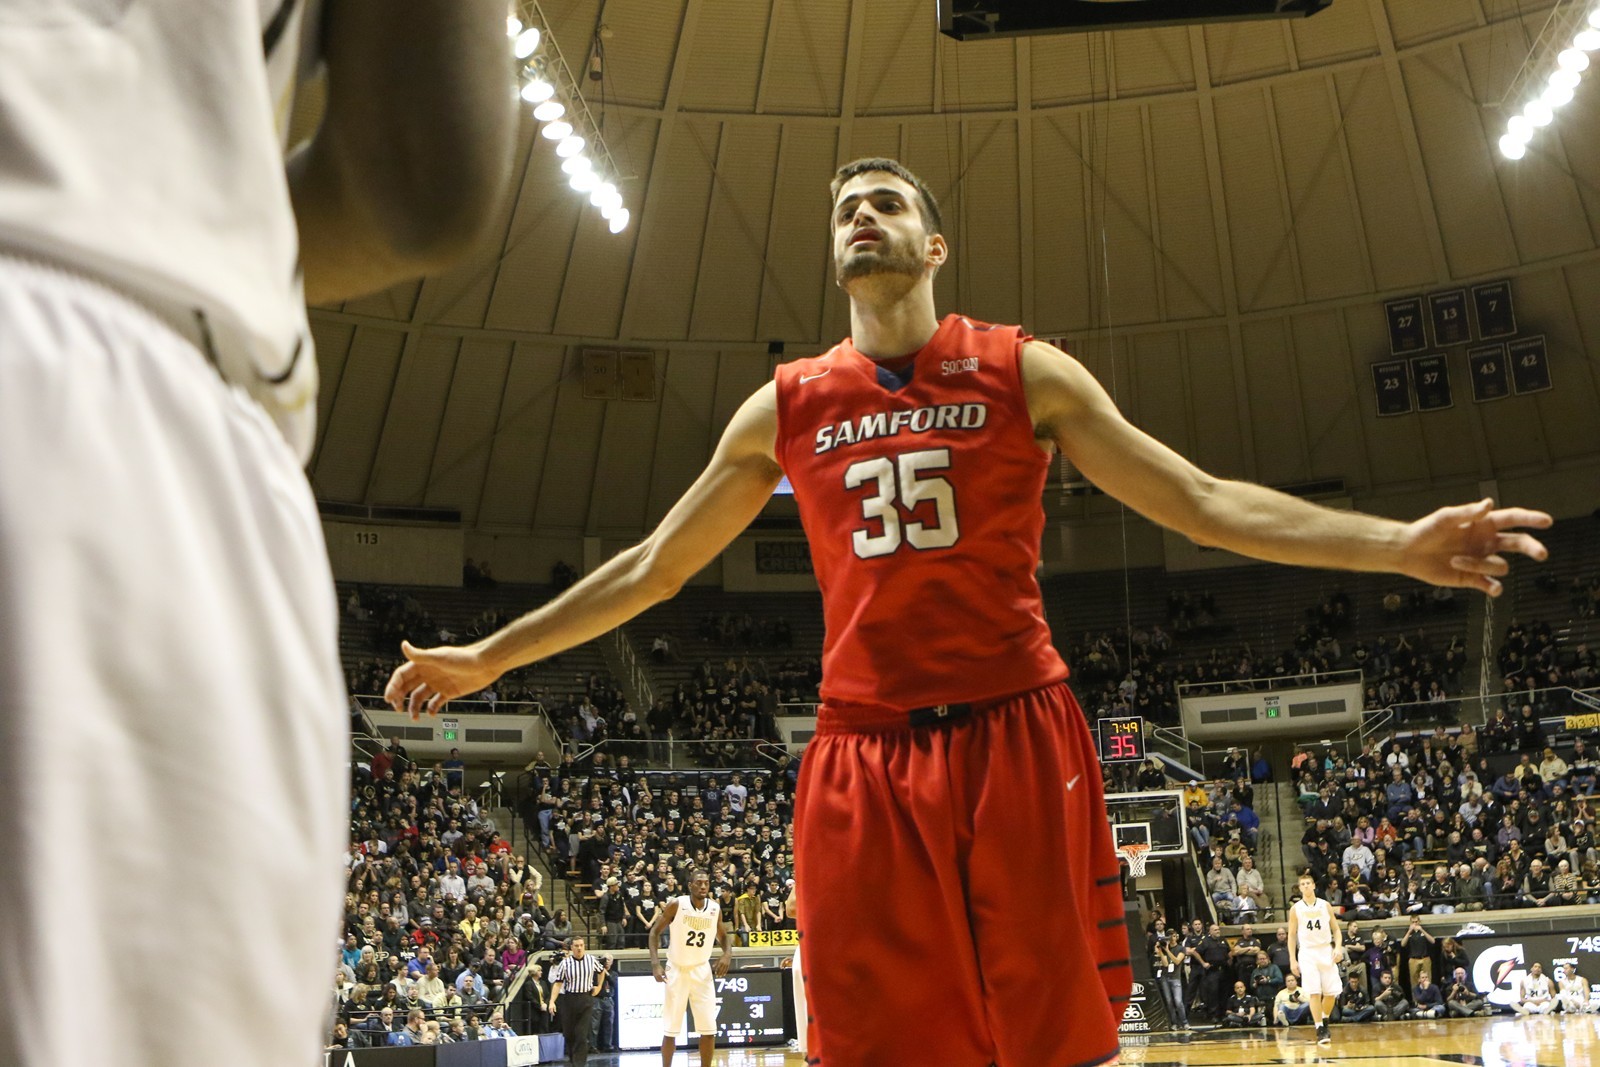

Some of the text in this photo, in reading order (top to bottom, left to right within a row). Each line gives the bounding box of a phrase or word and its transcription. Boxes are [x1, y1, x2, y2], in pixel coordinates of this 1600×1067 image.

[1489, 301, 1498, 313] 7
[1443, 308, 1458, 320] 13
[1398, 316, 1413, 329] 27
[942, 358, 979, 376] SOCON
[1522, 355, 1537, 367] 42
[1481, 363, 1496, 375] 43
[1384, 379, 1399, 391] 23
[1424, 373, 1439, 385] 37
[816, 404, 988, 455] SAMFORD
[845, 449, 960, 560] 35
[357, 534, 378, 545] 113
[1112, 722, 1138, 734] 7:49
[1111, 736, 1136, 758] 35
[1307, 920, 1321, 931] 44
[686, 931, 706, 948] 23
[1473, 944, 1527, 1005] G
[716, 978, 748, 993] 7:49
[624, 1004, 665, 1021] SUBW
[750, 1004, 764, 1019] 31
